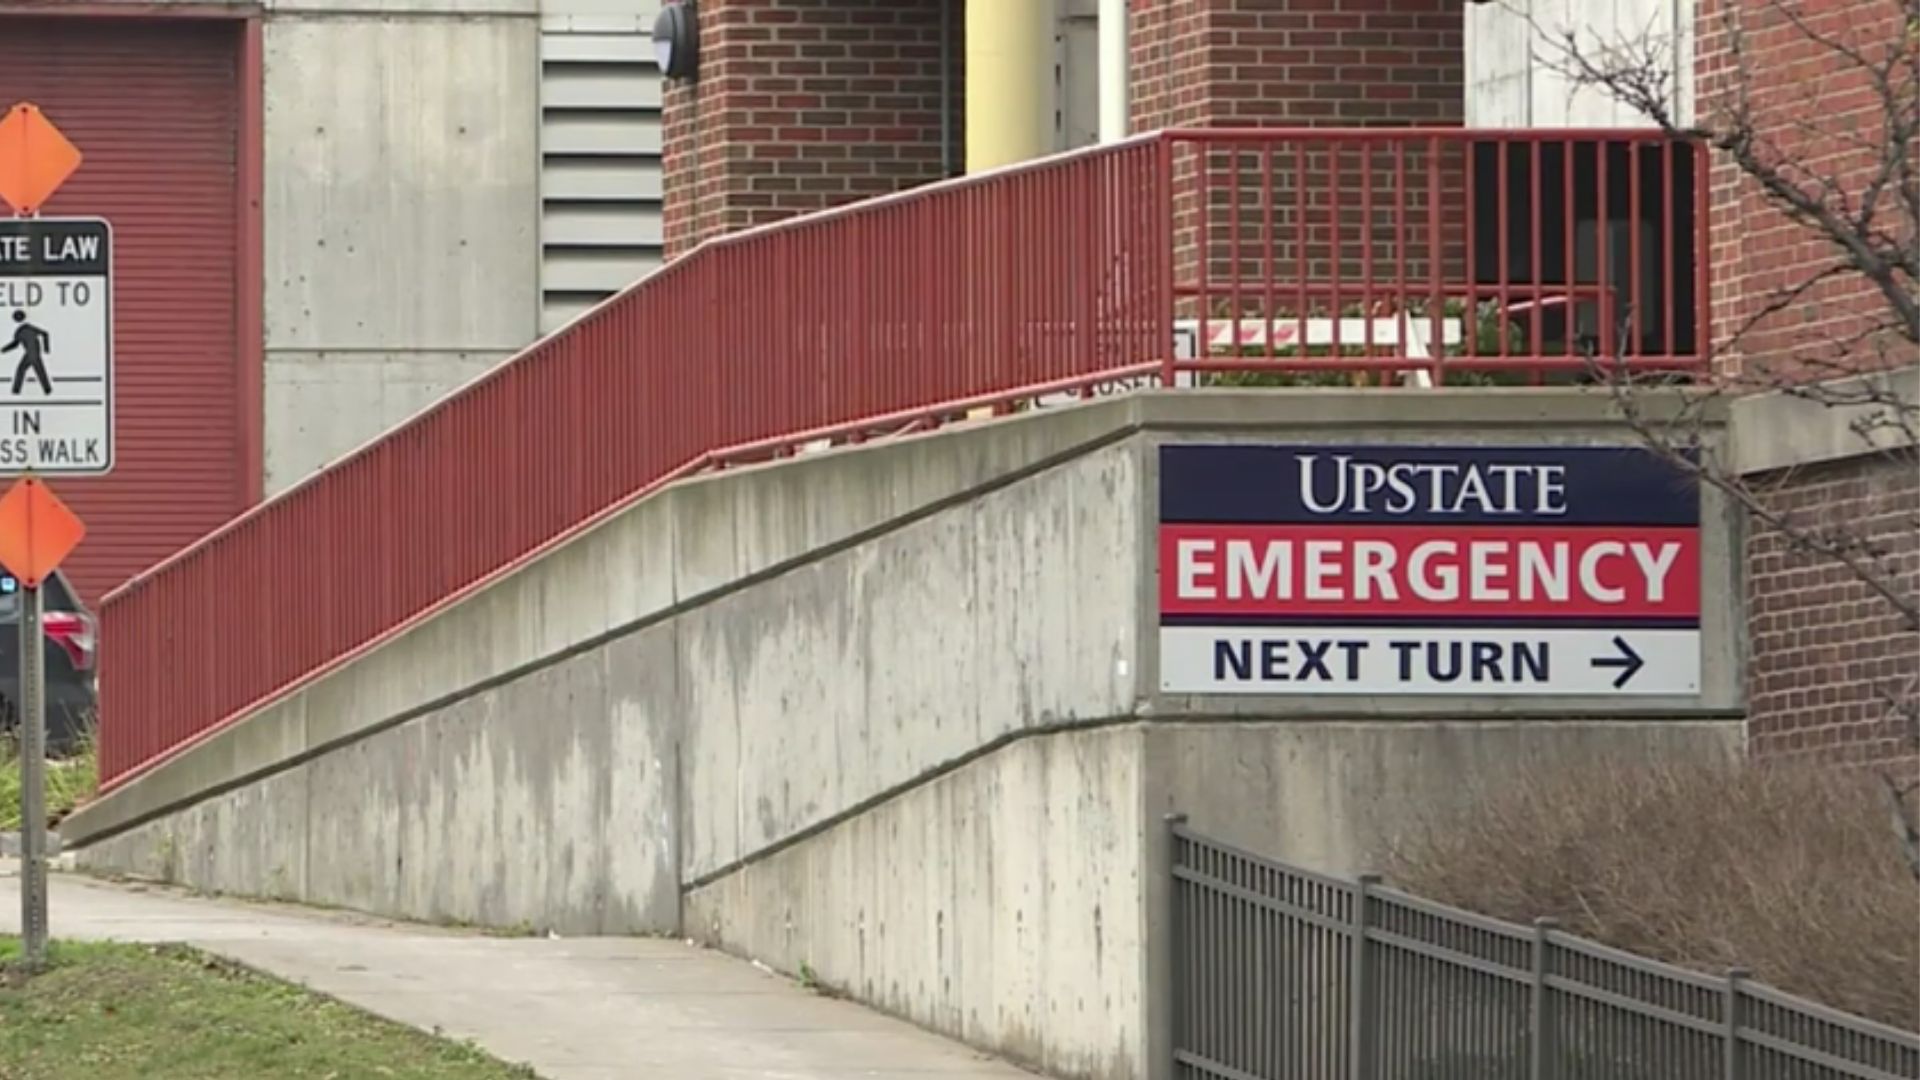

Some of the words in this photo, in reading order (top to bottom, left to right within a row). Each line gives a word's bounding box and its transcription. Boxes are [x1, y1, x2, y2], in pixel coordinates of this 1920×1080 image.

[0, 236, 31, 261] TE
[43, 236, 100, 261] LAW
[56, 282, 91, 307] TO
[13, 409, 41, 435] IN
[38, 438, 100, 463] WALK
[1295, 456, 1568, 515] UPSTATE
[1177, 540, 1682, 603] EMERGENCY
[1214, 639, 1369, 682] NEXT
[1390, 640, 1550, 683] TURN
